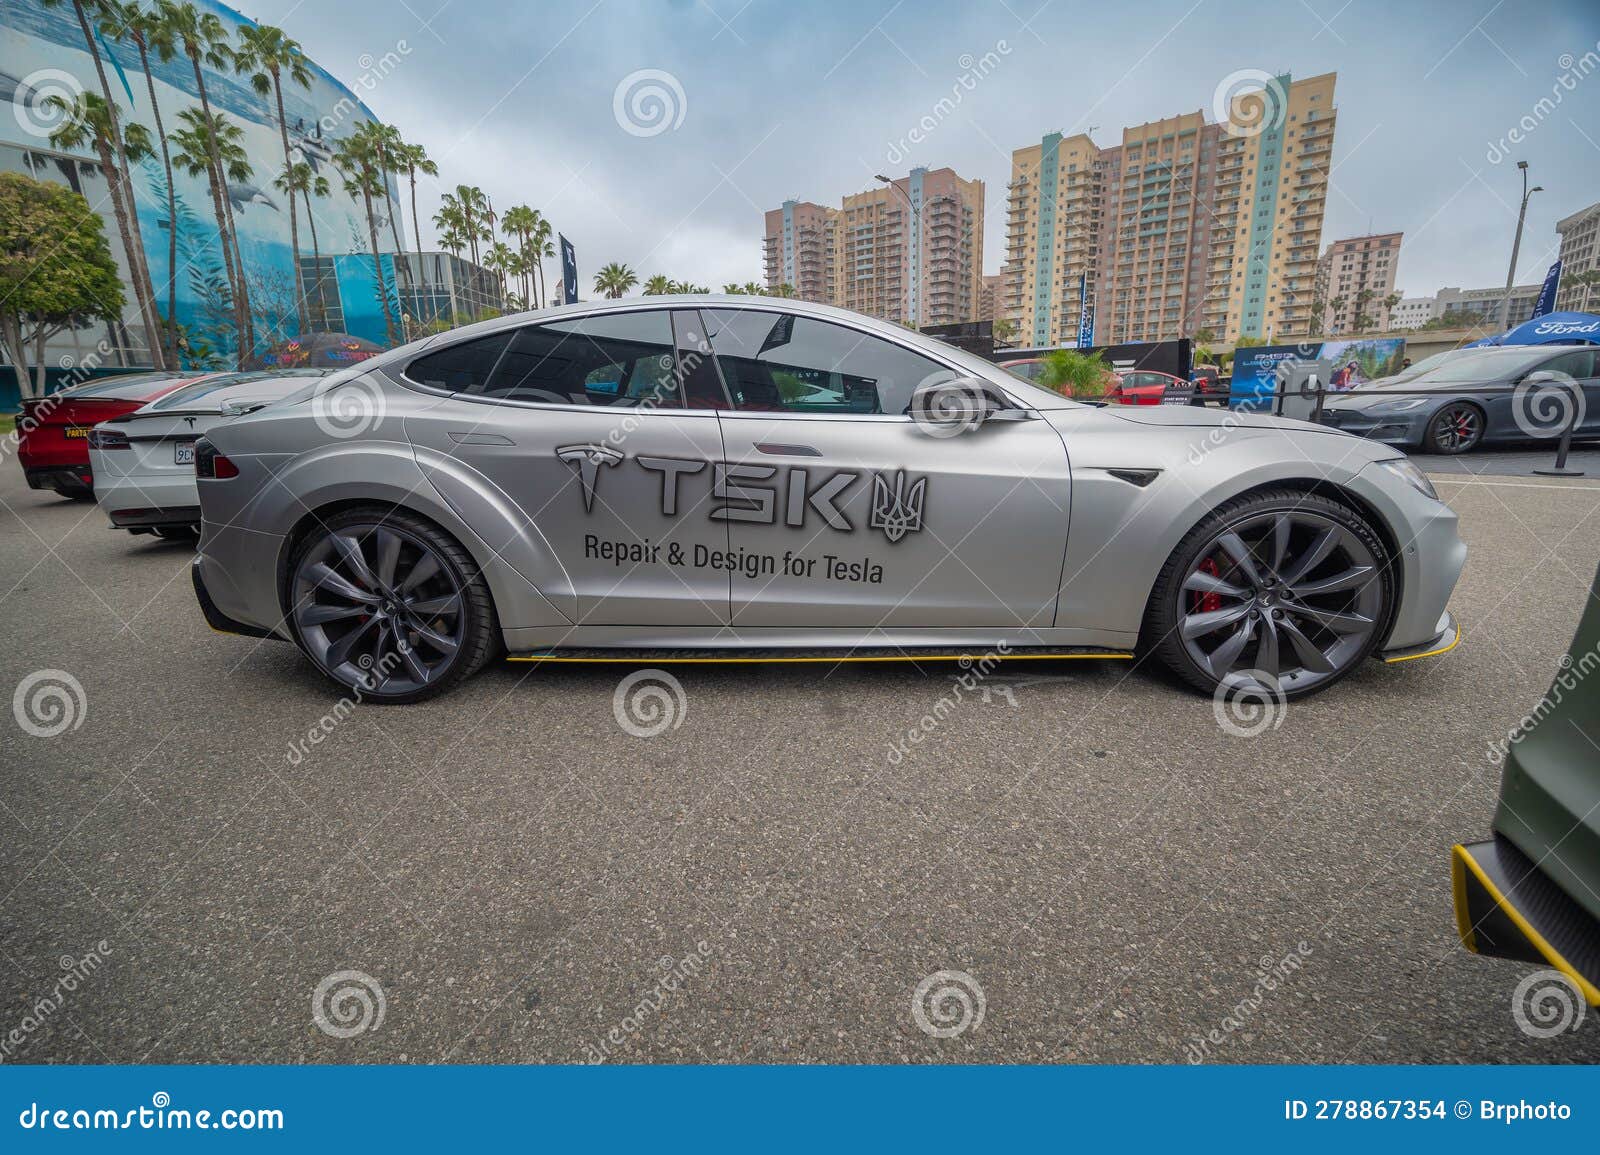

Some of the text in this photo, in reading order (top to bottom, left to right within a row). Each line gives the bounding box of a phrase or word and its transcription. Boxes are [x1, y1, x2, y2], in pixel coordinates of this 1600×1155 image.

[1535, 321, 1600, 335] Ford
[634, 456, 858, 531] TSK
[584, 534, 883, 584] Repair & Design for Tesla
